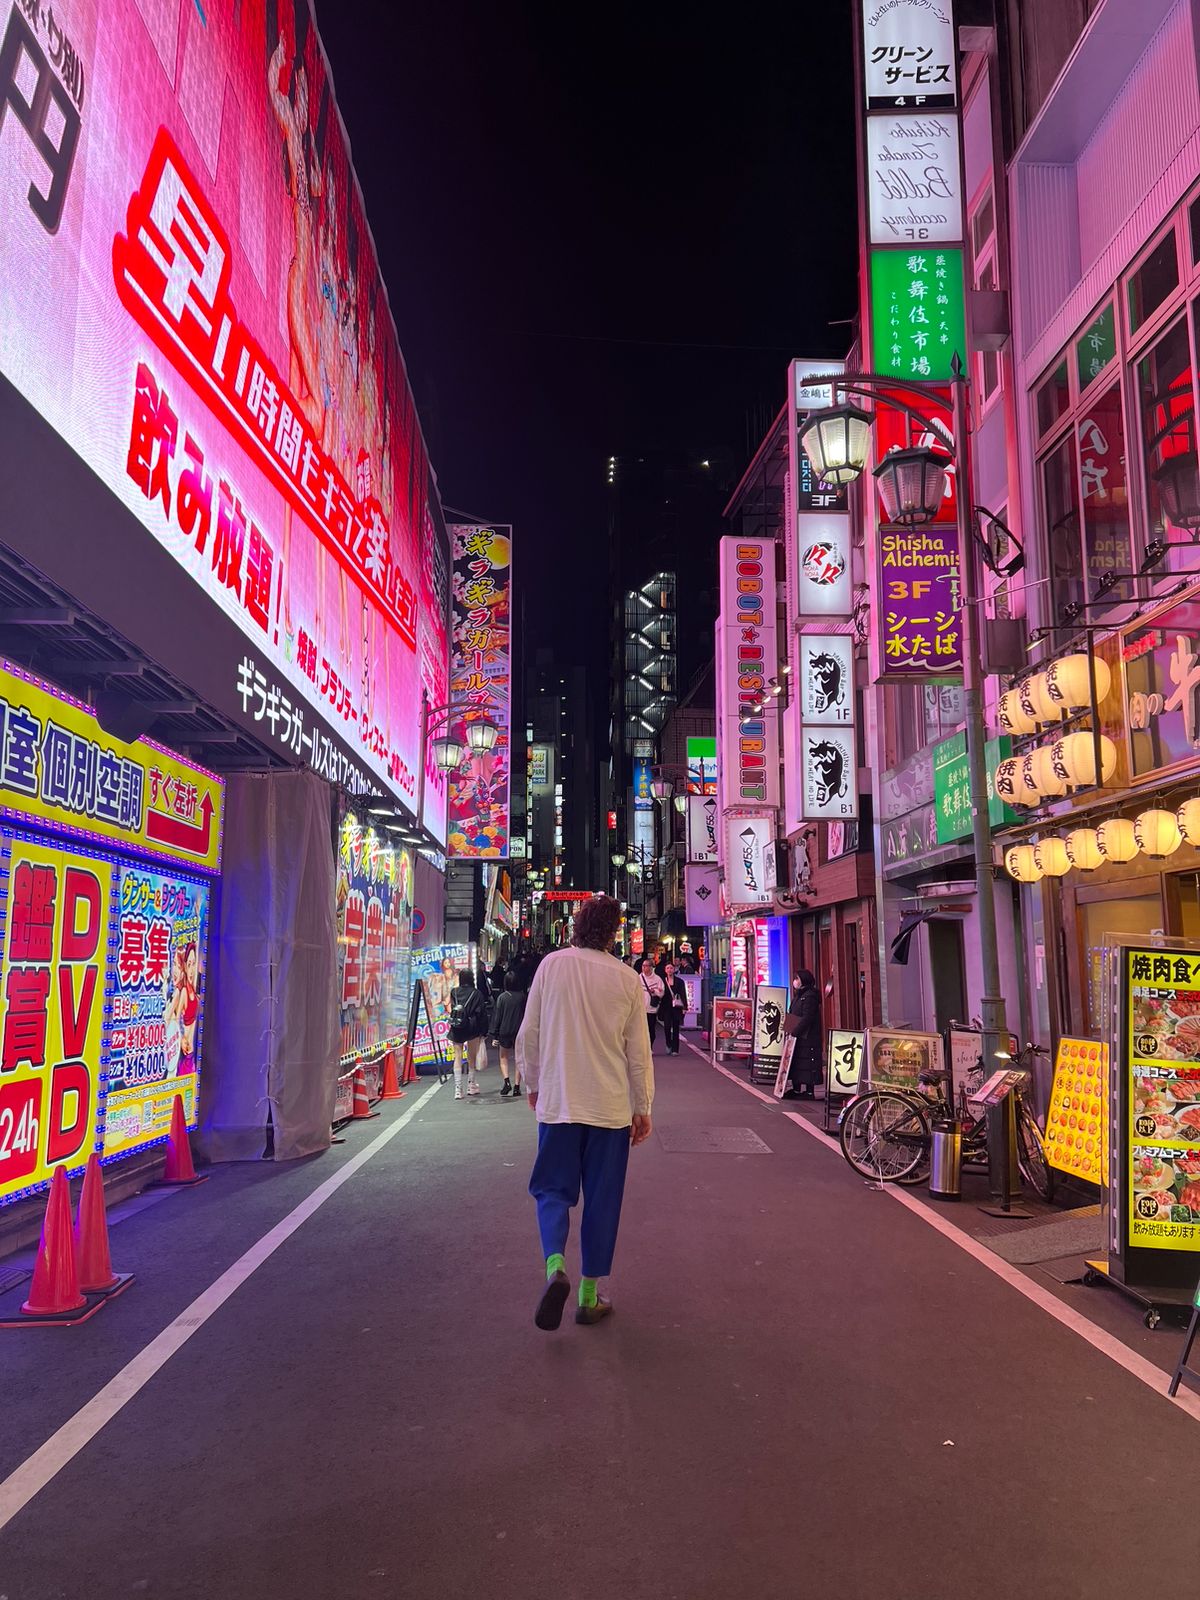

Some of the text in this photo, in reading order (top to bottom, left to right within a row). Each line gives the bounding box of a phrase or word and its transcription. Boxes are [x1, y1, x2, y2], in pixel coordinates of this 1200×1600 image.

[871, 46, 934, 63] クリーン
[884, 65, 951, 84] サービス
[890, 291, 901, 367] こだわり食材
[906, 254, 932, 376] 歌舞伎市場
[127, 362, 284, 647] 飲み放題!
[882, 533, 944, 552] Shisha
[888, 580, 932, 599] 3F
[465, 529, 495, 710] ギラギラガールズ
[736, 543, 767, 801] ROBOT RESTAURANT
[835, 708, 851, 720] 1F
[0, 696, 145, 832] 室個別空調
[149, 766, 198, 822] すぐ左折
[840, 803, 853, 814] B1
[1, 860, 57, 1073] 鑑賞
[118, 914, 171, 988] 募集
[411, 948, 444, 967] SPECIAL
[733, 936, 747, 972] PINK
[46, 867, 102, 1167] DVD
[112, 995, 131, 1021] 日給
[0, 1098, 39, 1162] 24h
[1133, 1145, 1188, 1159] プレミアムコース
[1134, 1222, 1196, 1238] 飲み放題もあります
